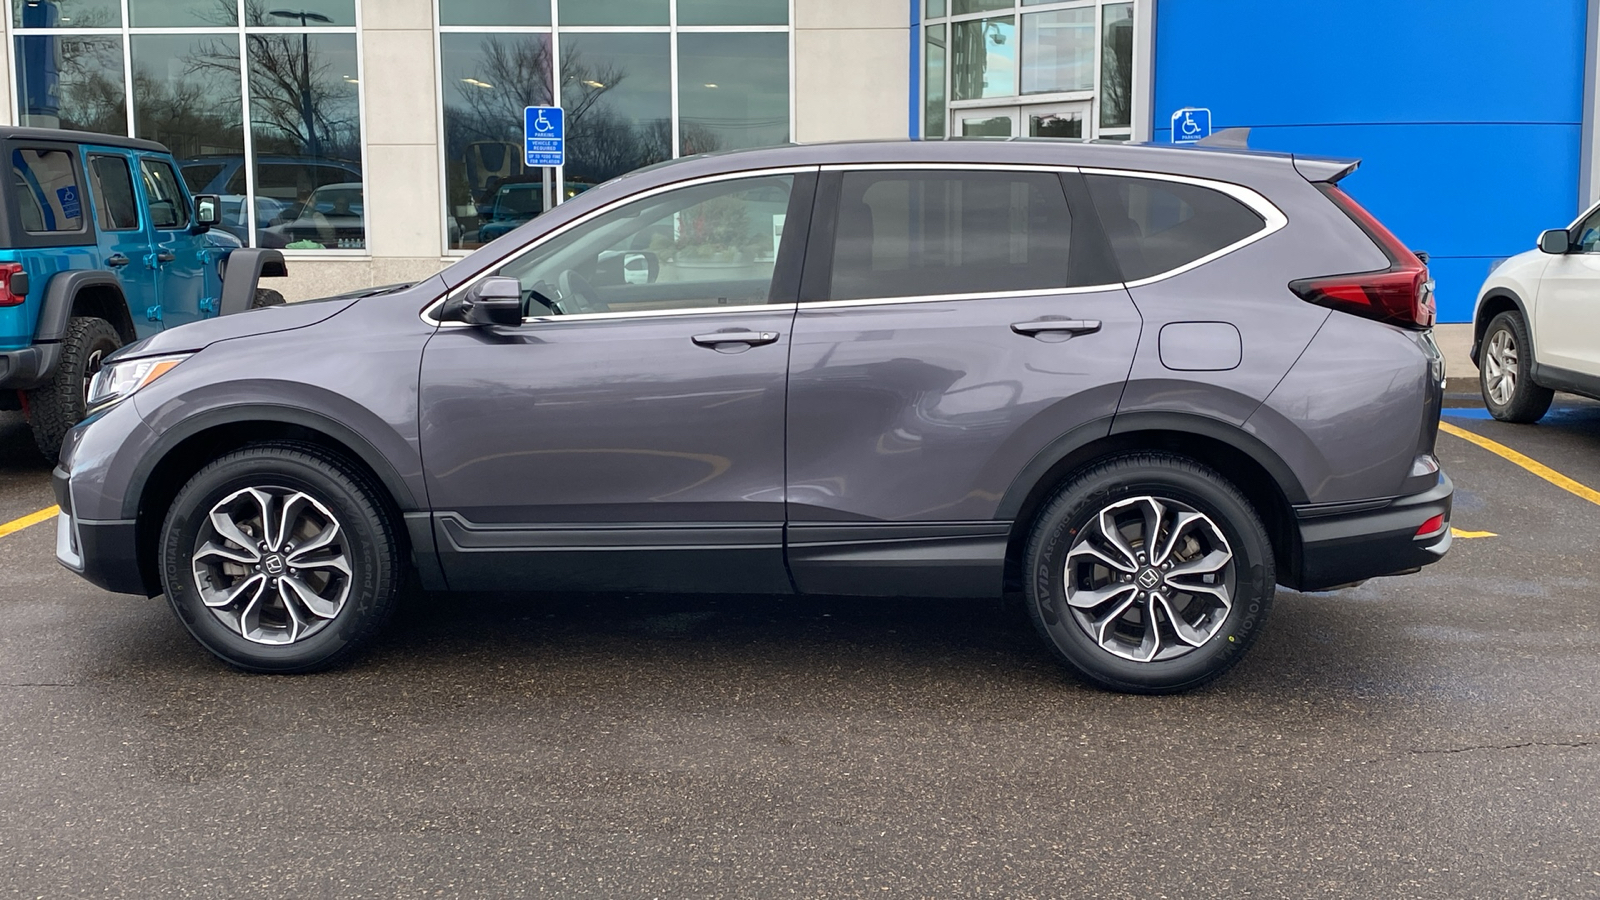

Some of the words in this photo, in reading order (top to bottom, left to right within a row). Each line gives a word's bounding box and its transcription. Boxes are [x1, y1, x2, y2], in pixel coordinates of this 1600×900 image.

[170, 526, 182, 598] YOKOHAMA
[358, 537, 374, 590] Ascend
[1038, 564, 1052, 612] AVID
[1046, 517, 1071, 564] Ascend
[356, 590, 371, 614] LX
[1214, 596, 1261, 660] YOKOHAMA
